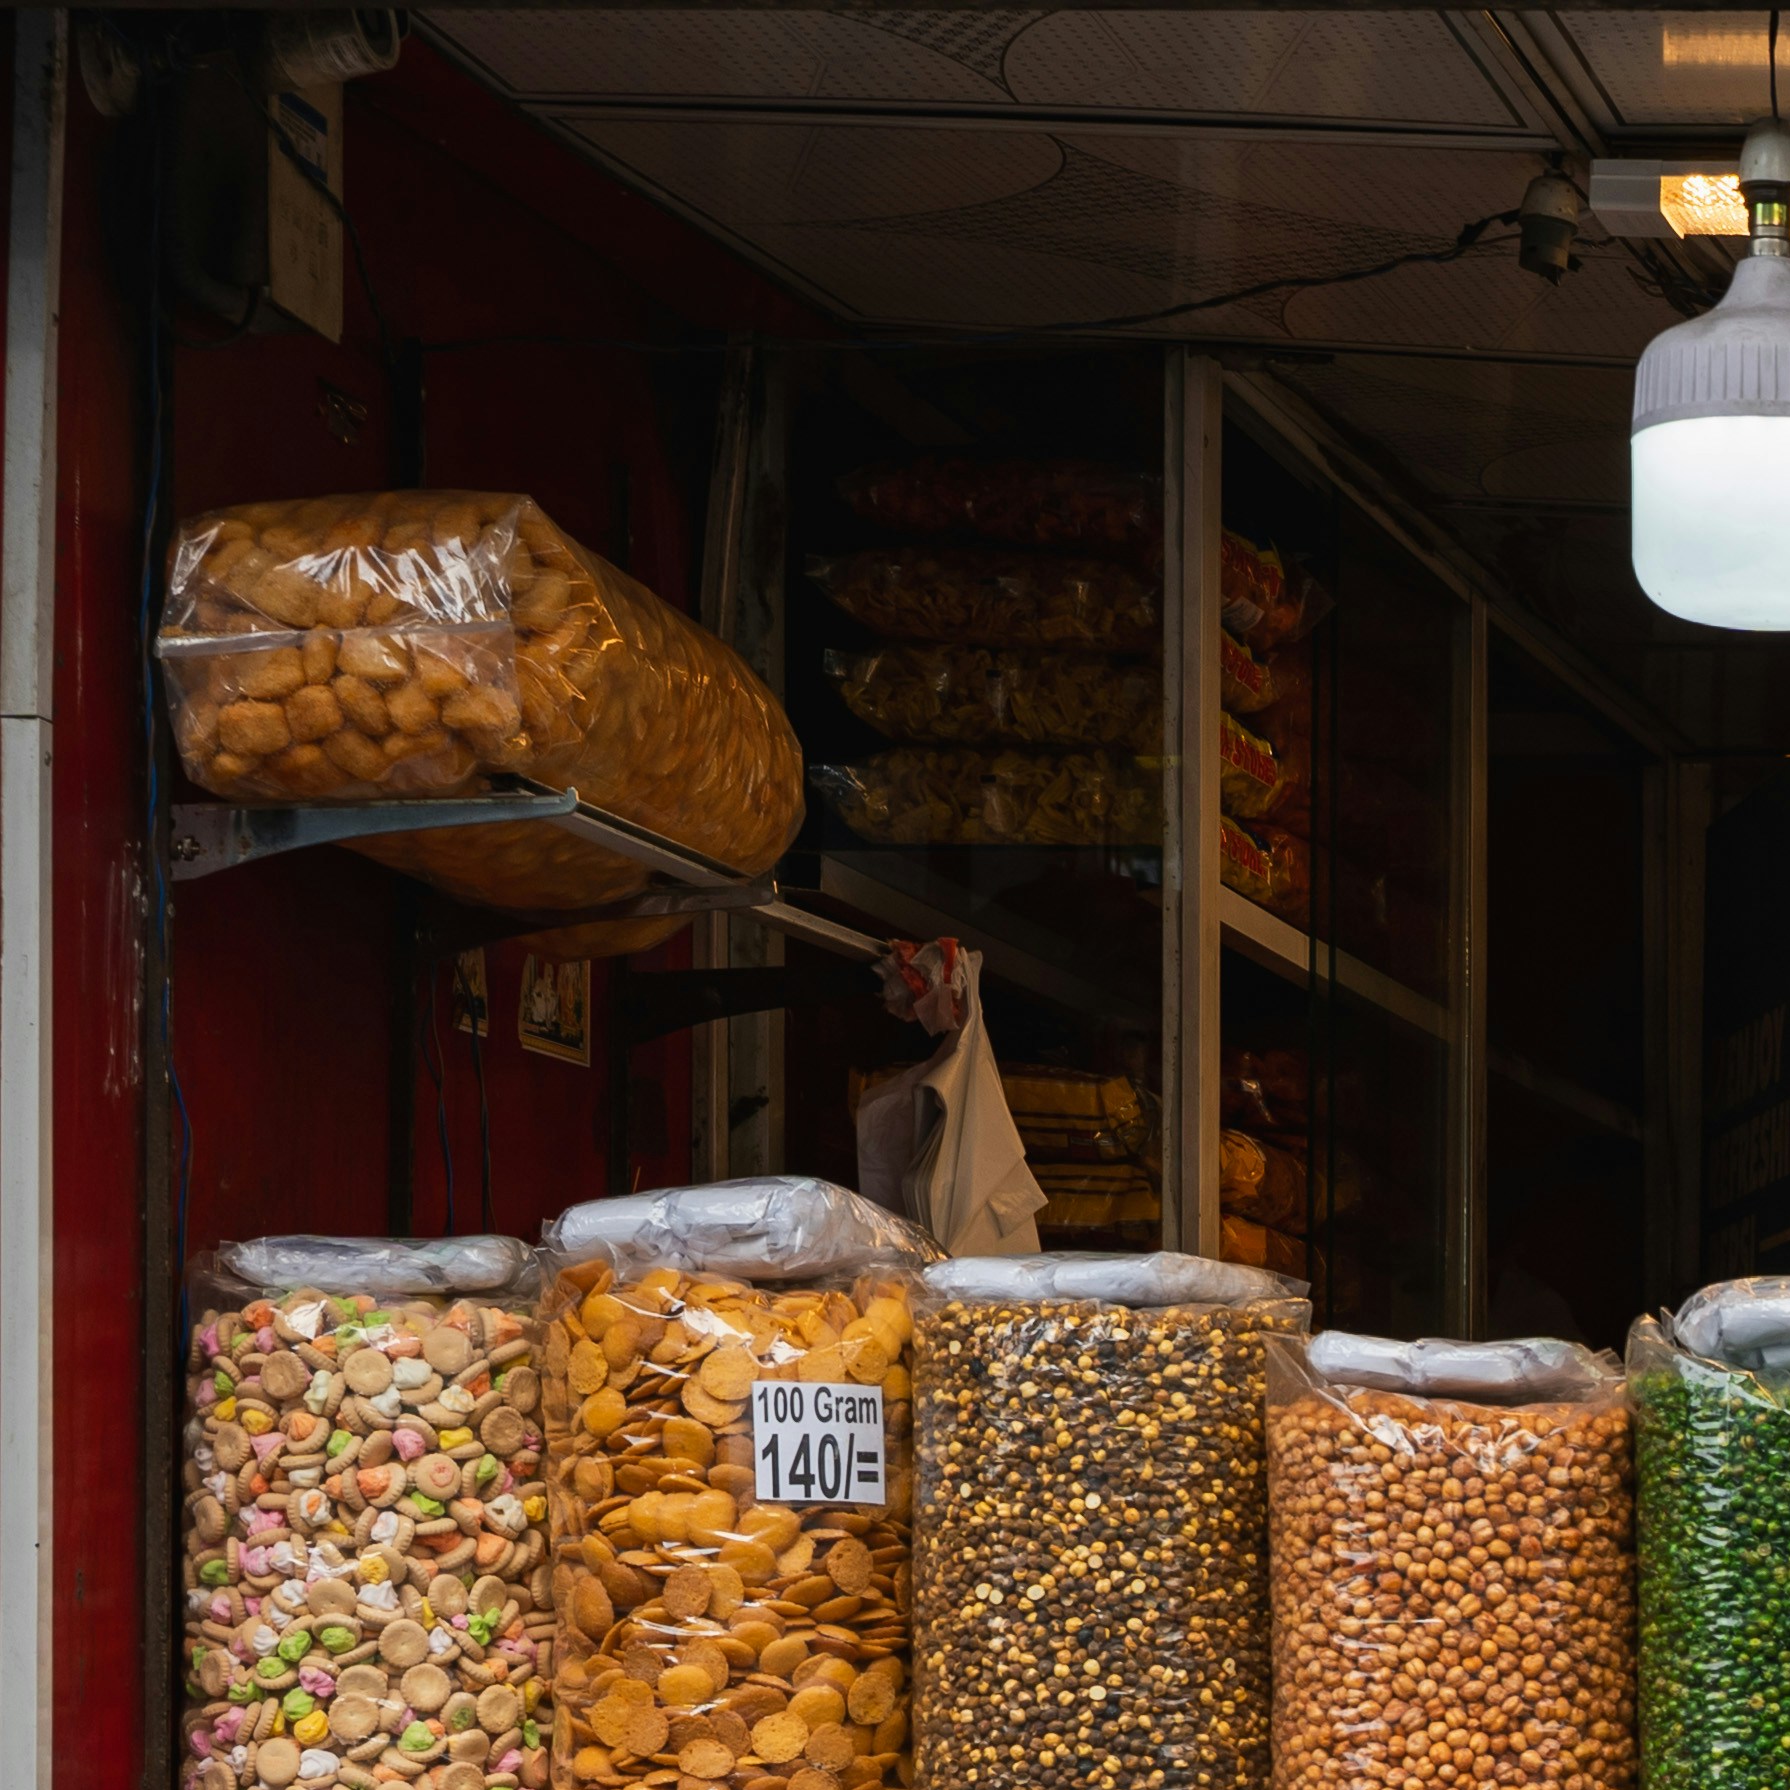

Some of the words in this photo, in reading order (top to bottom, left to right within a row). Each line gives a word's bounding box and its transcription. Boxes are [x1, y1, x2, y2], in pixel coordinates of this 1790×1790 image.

[759, 1387, 804, 1423] 100
[815, 1386, 877, 1424] Gram
[762, 1433, 879, 1499] 140/=
